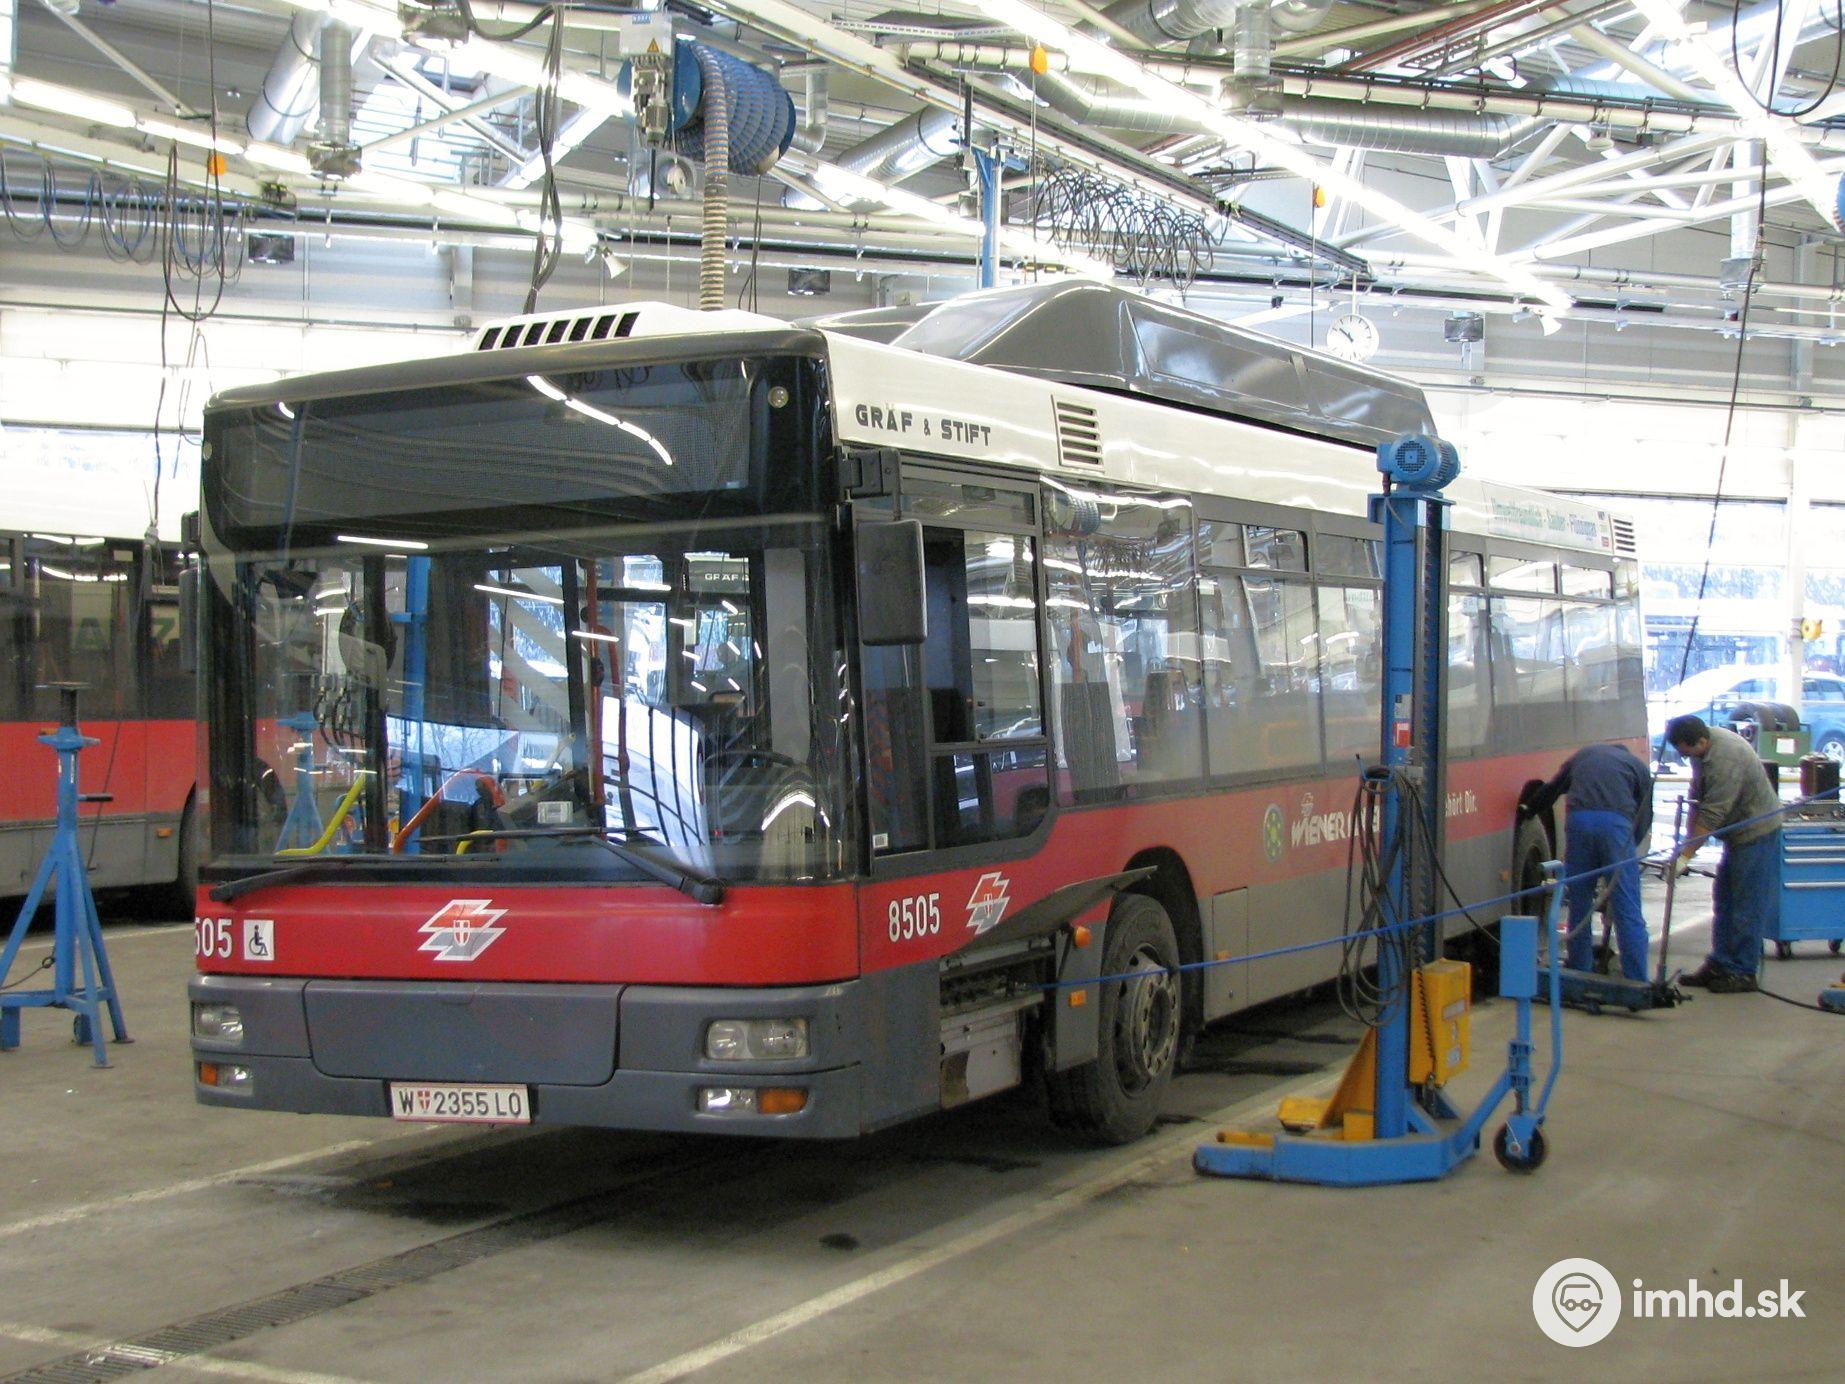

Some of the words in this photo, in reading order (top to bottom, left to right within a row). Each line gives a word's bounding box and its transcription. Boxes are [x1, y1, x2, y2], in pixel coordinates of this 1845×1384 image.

[923, 418, 931, 436] &
[941, 419, 991, 446] STIFT
[1291, 811, 1346, 848] WIENER
[888, 892, 940, 943] 8505
[399, 1090, 413, 1114] W
[433, 1091, 489, 1116] 2355
